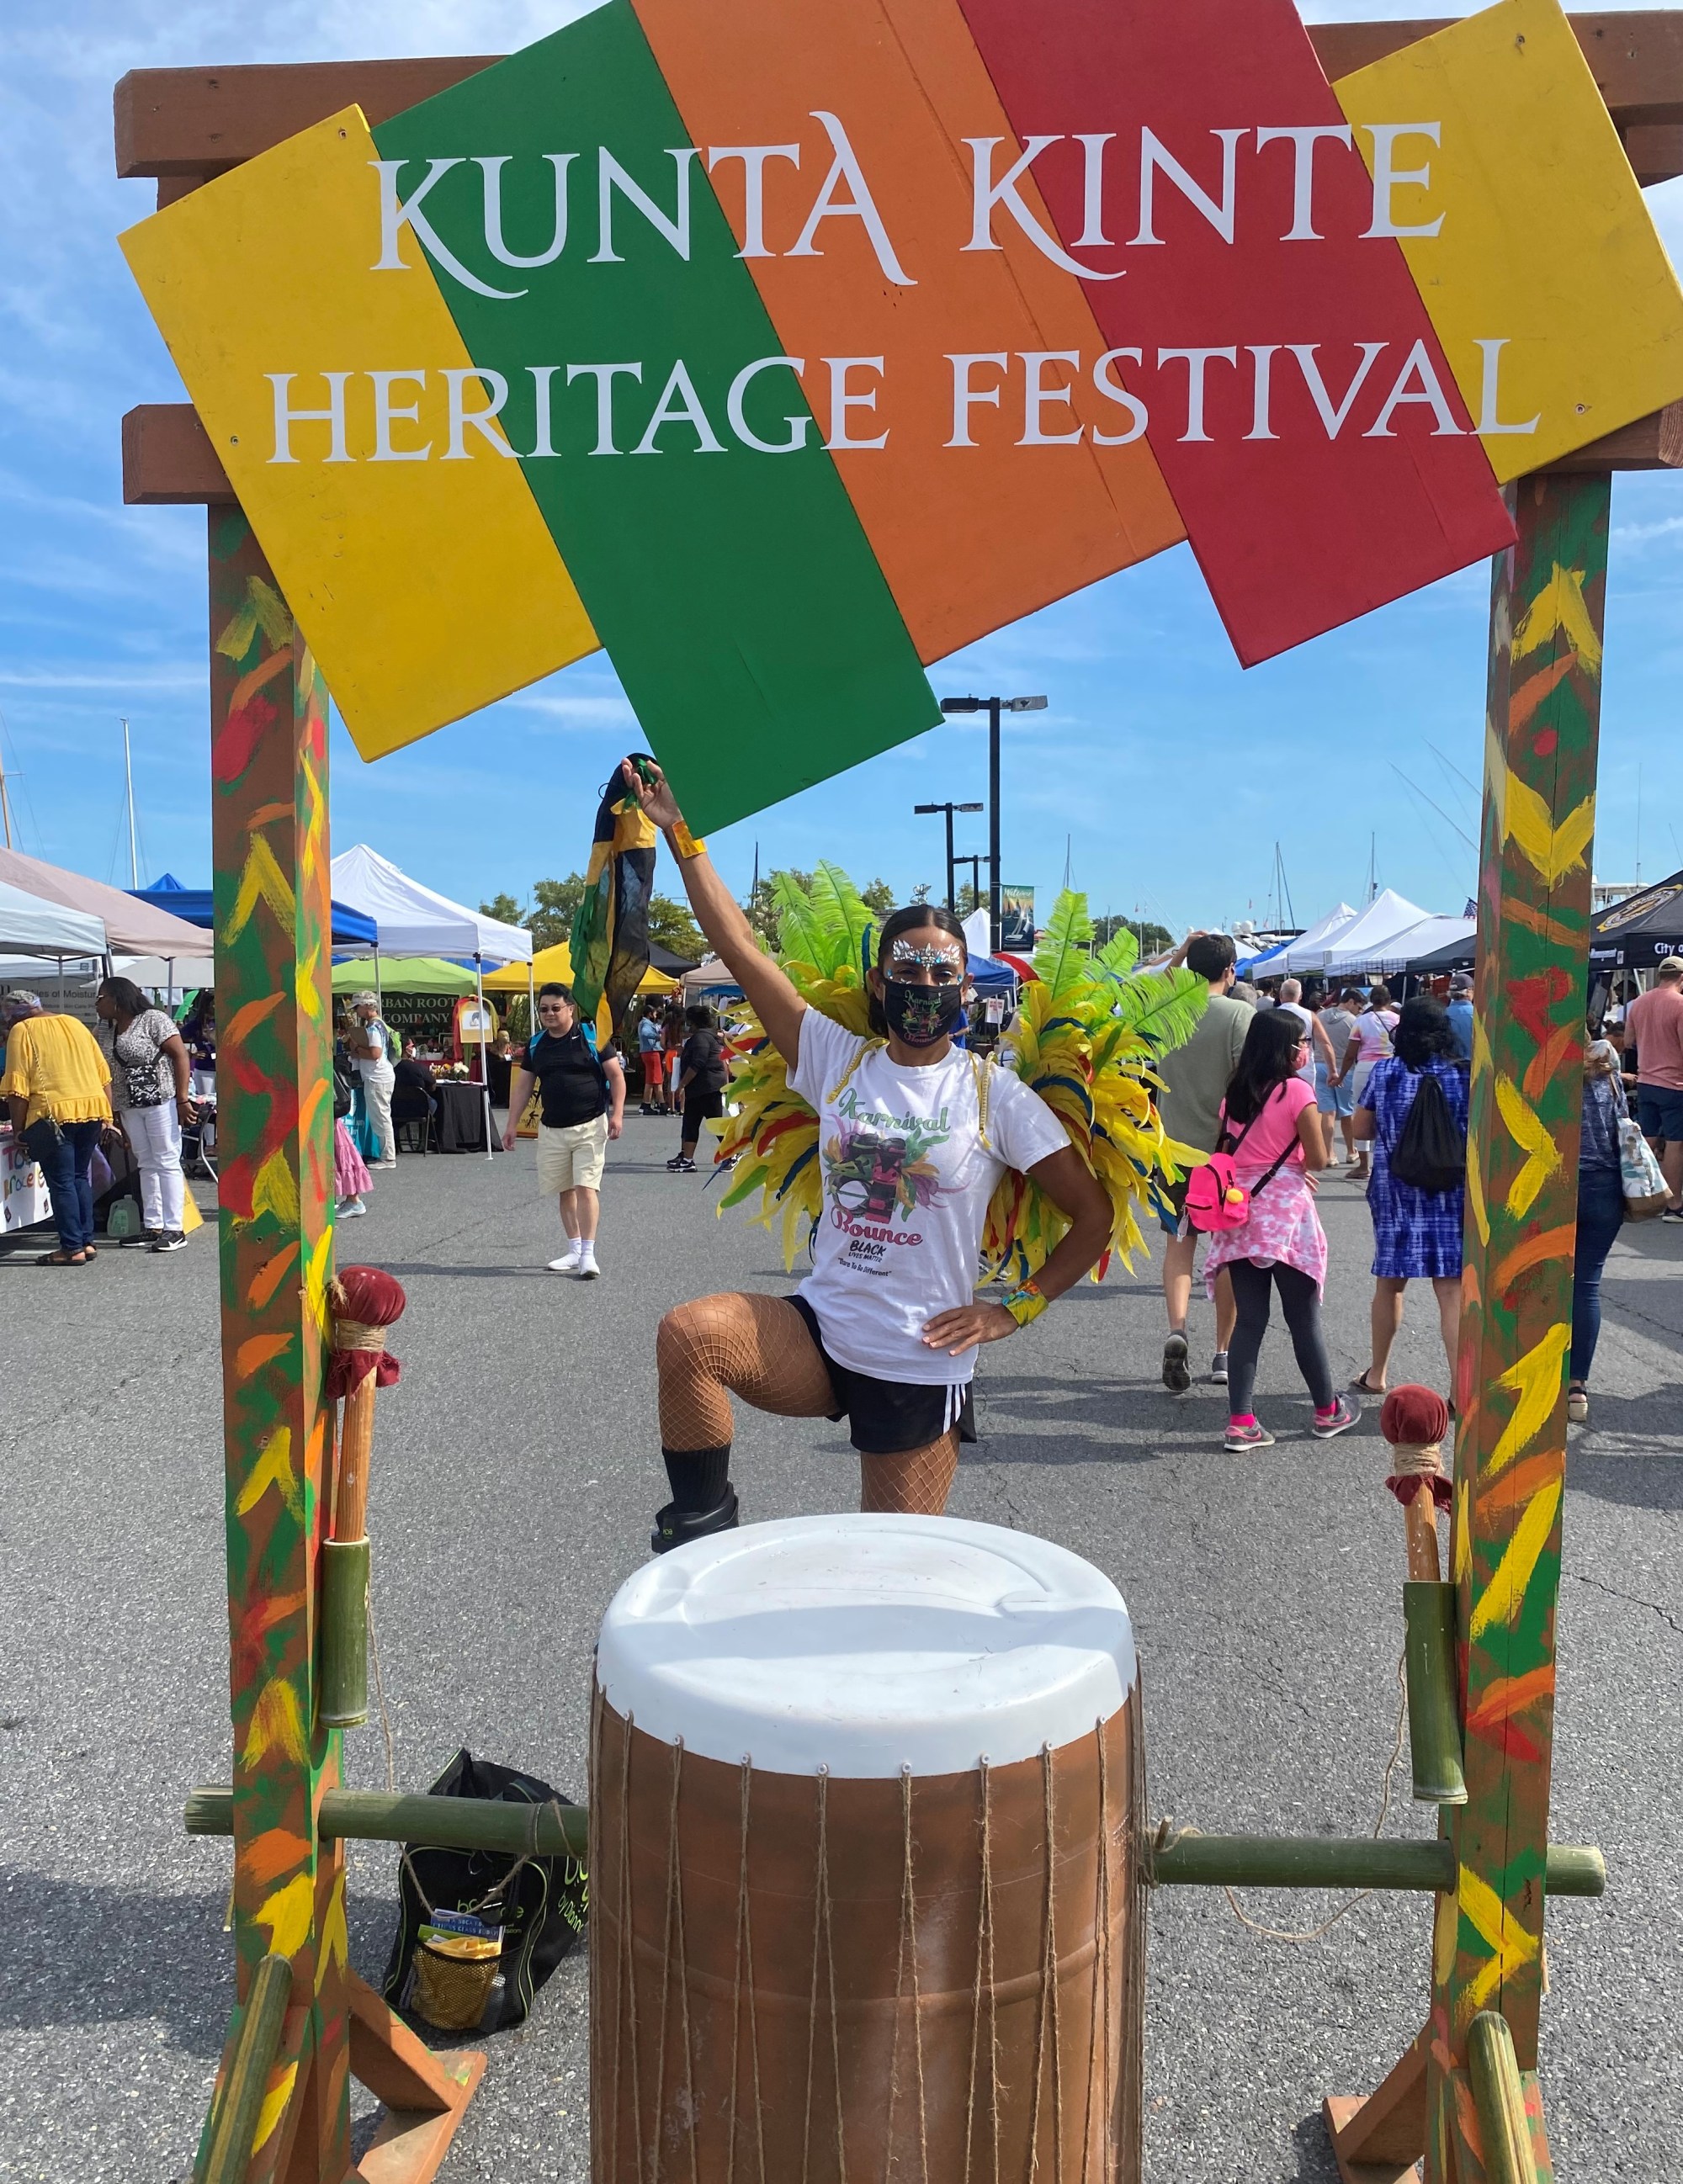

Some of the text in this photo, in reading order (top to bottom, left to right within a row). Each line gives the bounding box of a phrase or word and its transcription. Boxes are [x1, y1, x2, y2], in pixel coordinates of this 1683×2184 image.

[369, 111, 1447, 300] KUNTA KINTE
[263, 338, 1542, 464] HERITAGE FESTIVAL
[1654, 941, 1675, 957] City
[63, 989, 98, 999] Moistur
[381, 997, 459, 1008] RBAN ROOT
[383, 1012, 449, 1024] COMPANY
[839, 1088, 951, 1132] Karnival
[831, 1204, 924, 1247] Bounce
[849, 1239, 887, 1257] BLACK
[848, 1251, 883, 1264] LIVES MATTER
